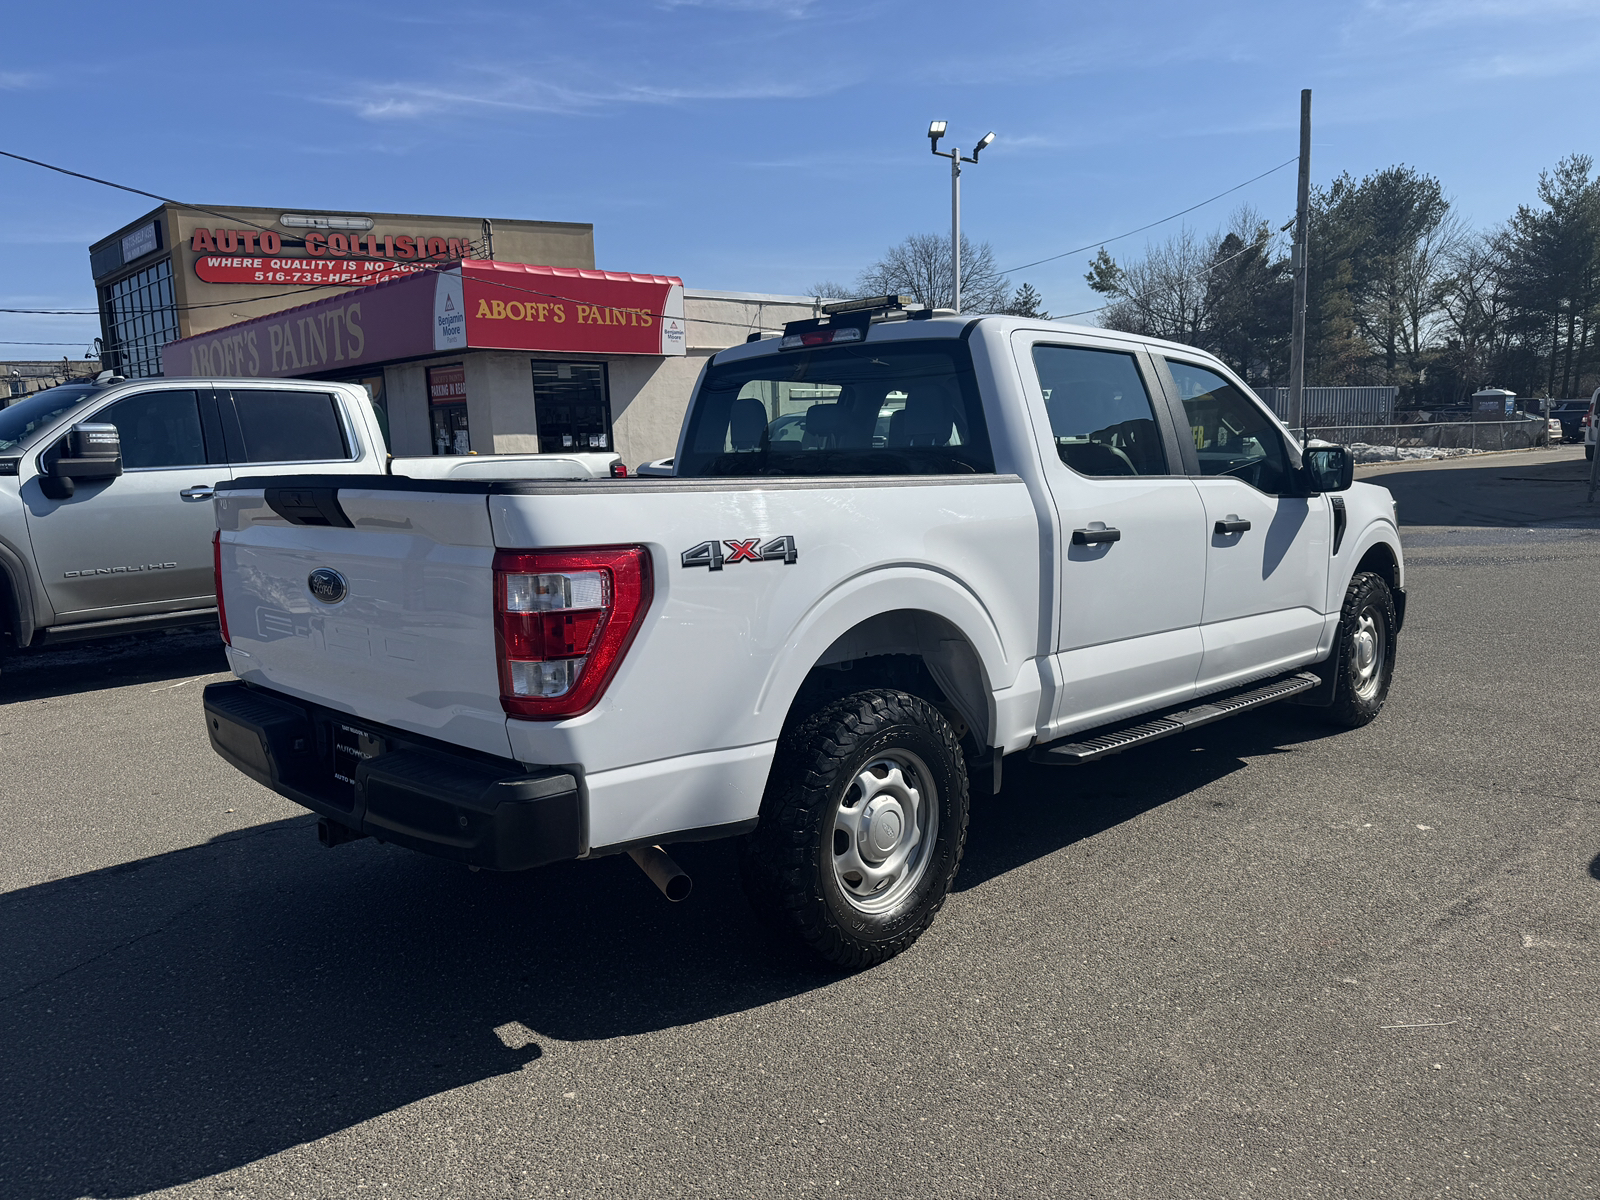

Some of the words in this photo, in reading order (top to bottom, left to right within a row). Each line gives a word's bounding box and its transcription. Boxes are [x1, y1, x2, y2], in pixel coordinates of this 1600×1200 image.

[191, 228, 281, 255] AUTO
[305, 232, 471, 260] COLLISION
[207, 257, 263, 268] WHERE
[270, 259, 336, 270] QUALITY
[343, 261, 357, 271] IS
[364, 262, 385, 271] NO
[254, 271, 372, 283] 516-735-HELP
[438, 312, 463, 327] Benjamin
[475, 299, 566, 323] ABOFF'S
[576, 305, 653, 327] PAINTS
[267, 302, 365, 372] PAINTS
[442, 326, 460, 336] Moore
[431, 384, 449, 397] PARKING
[449, 383, 455, 395] IN
[64, 565, 144, 578] DENALI
[148, 562, 177, 570] HD
[313, 574, 334, 596] Ford
[334, 773, 349, 783] AUTO
